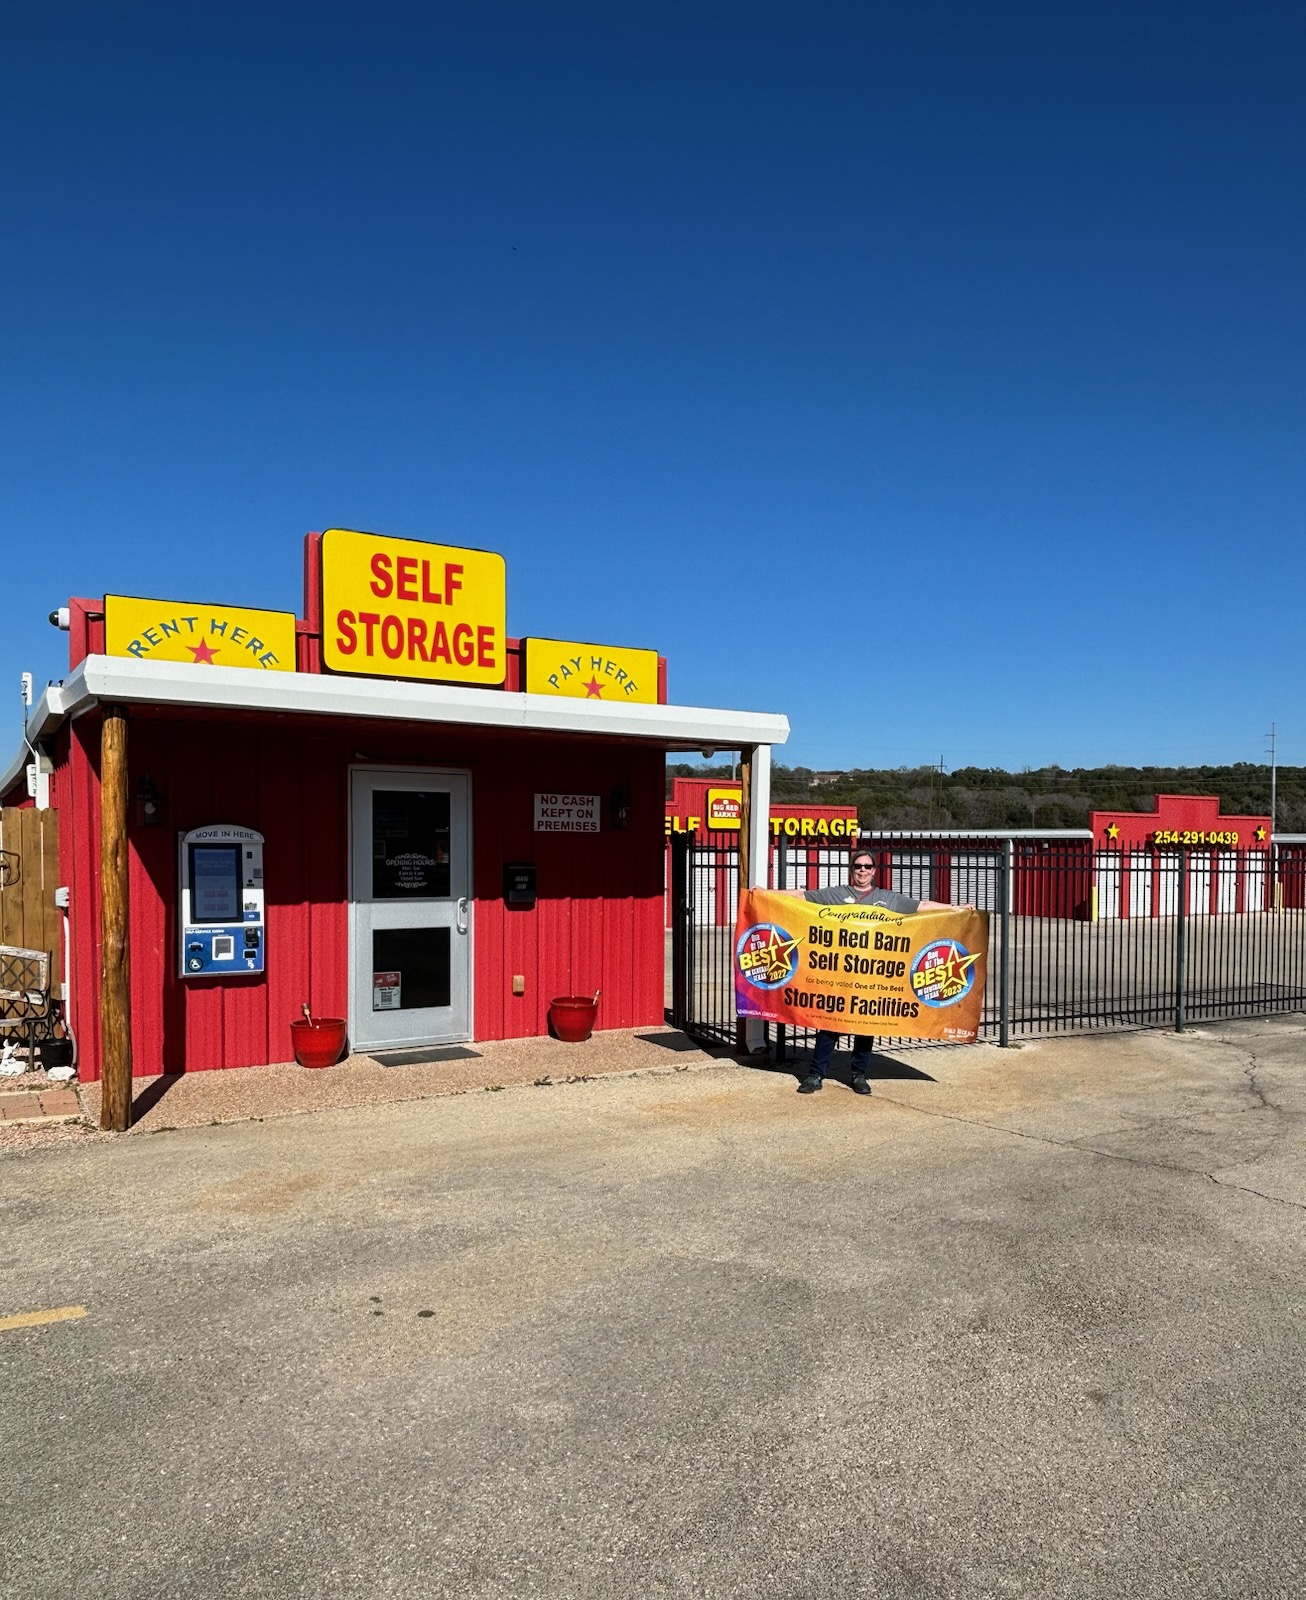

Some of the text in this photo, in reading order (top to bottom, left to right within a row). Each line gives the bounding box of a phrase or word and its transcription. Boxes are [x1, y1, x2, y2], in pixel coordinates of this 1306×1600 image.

[370, 553, 463, 605] SELF
[126, 617, 280, 669] RENT HERE
[336, 609, 496, 668] STORAGE
[548, 656, 638, 695] PAY HERE
[540, 795, 594, 806] NO CASH
[541, 808, 593, 819] KEPT ON
[195, 831, 218, 839] MOVE
[233, 832, 255, 840] HERE
[537, 821, 598, 831] PREMISES
[665, 816, 859, 837] ELF TORAGE
[1155, 830, 1239, 844] 254-291-0439
[818, 908, 904, 926] Congratulations
[809, 925, 911, 953] Big Red Barn
[739, 944, 778, 970] BEST
[809, 950, 839, 971] Self
[844, 953, 906, 978] Storage
[770, 969, 786, 981] 2022
[816, 978, 834, 987] being
[913, 961, 955, 989] BEST
[943, 985, 962, 998] 2023
[784, 988, 845, 1013] Storage
[850, 995, 919, 1018] Facilities
